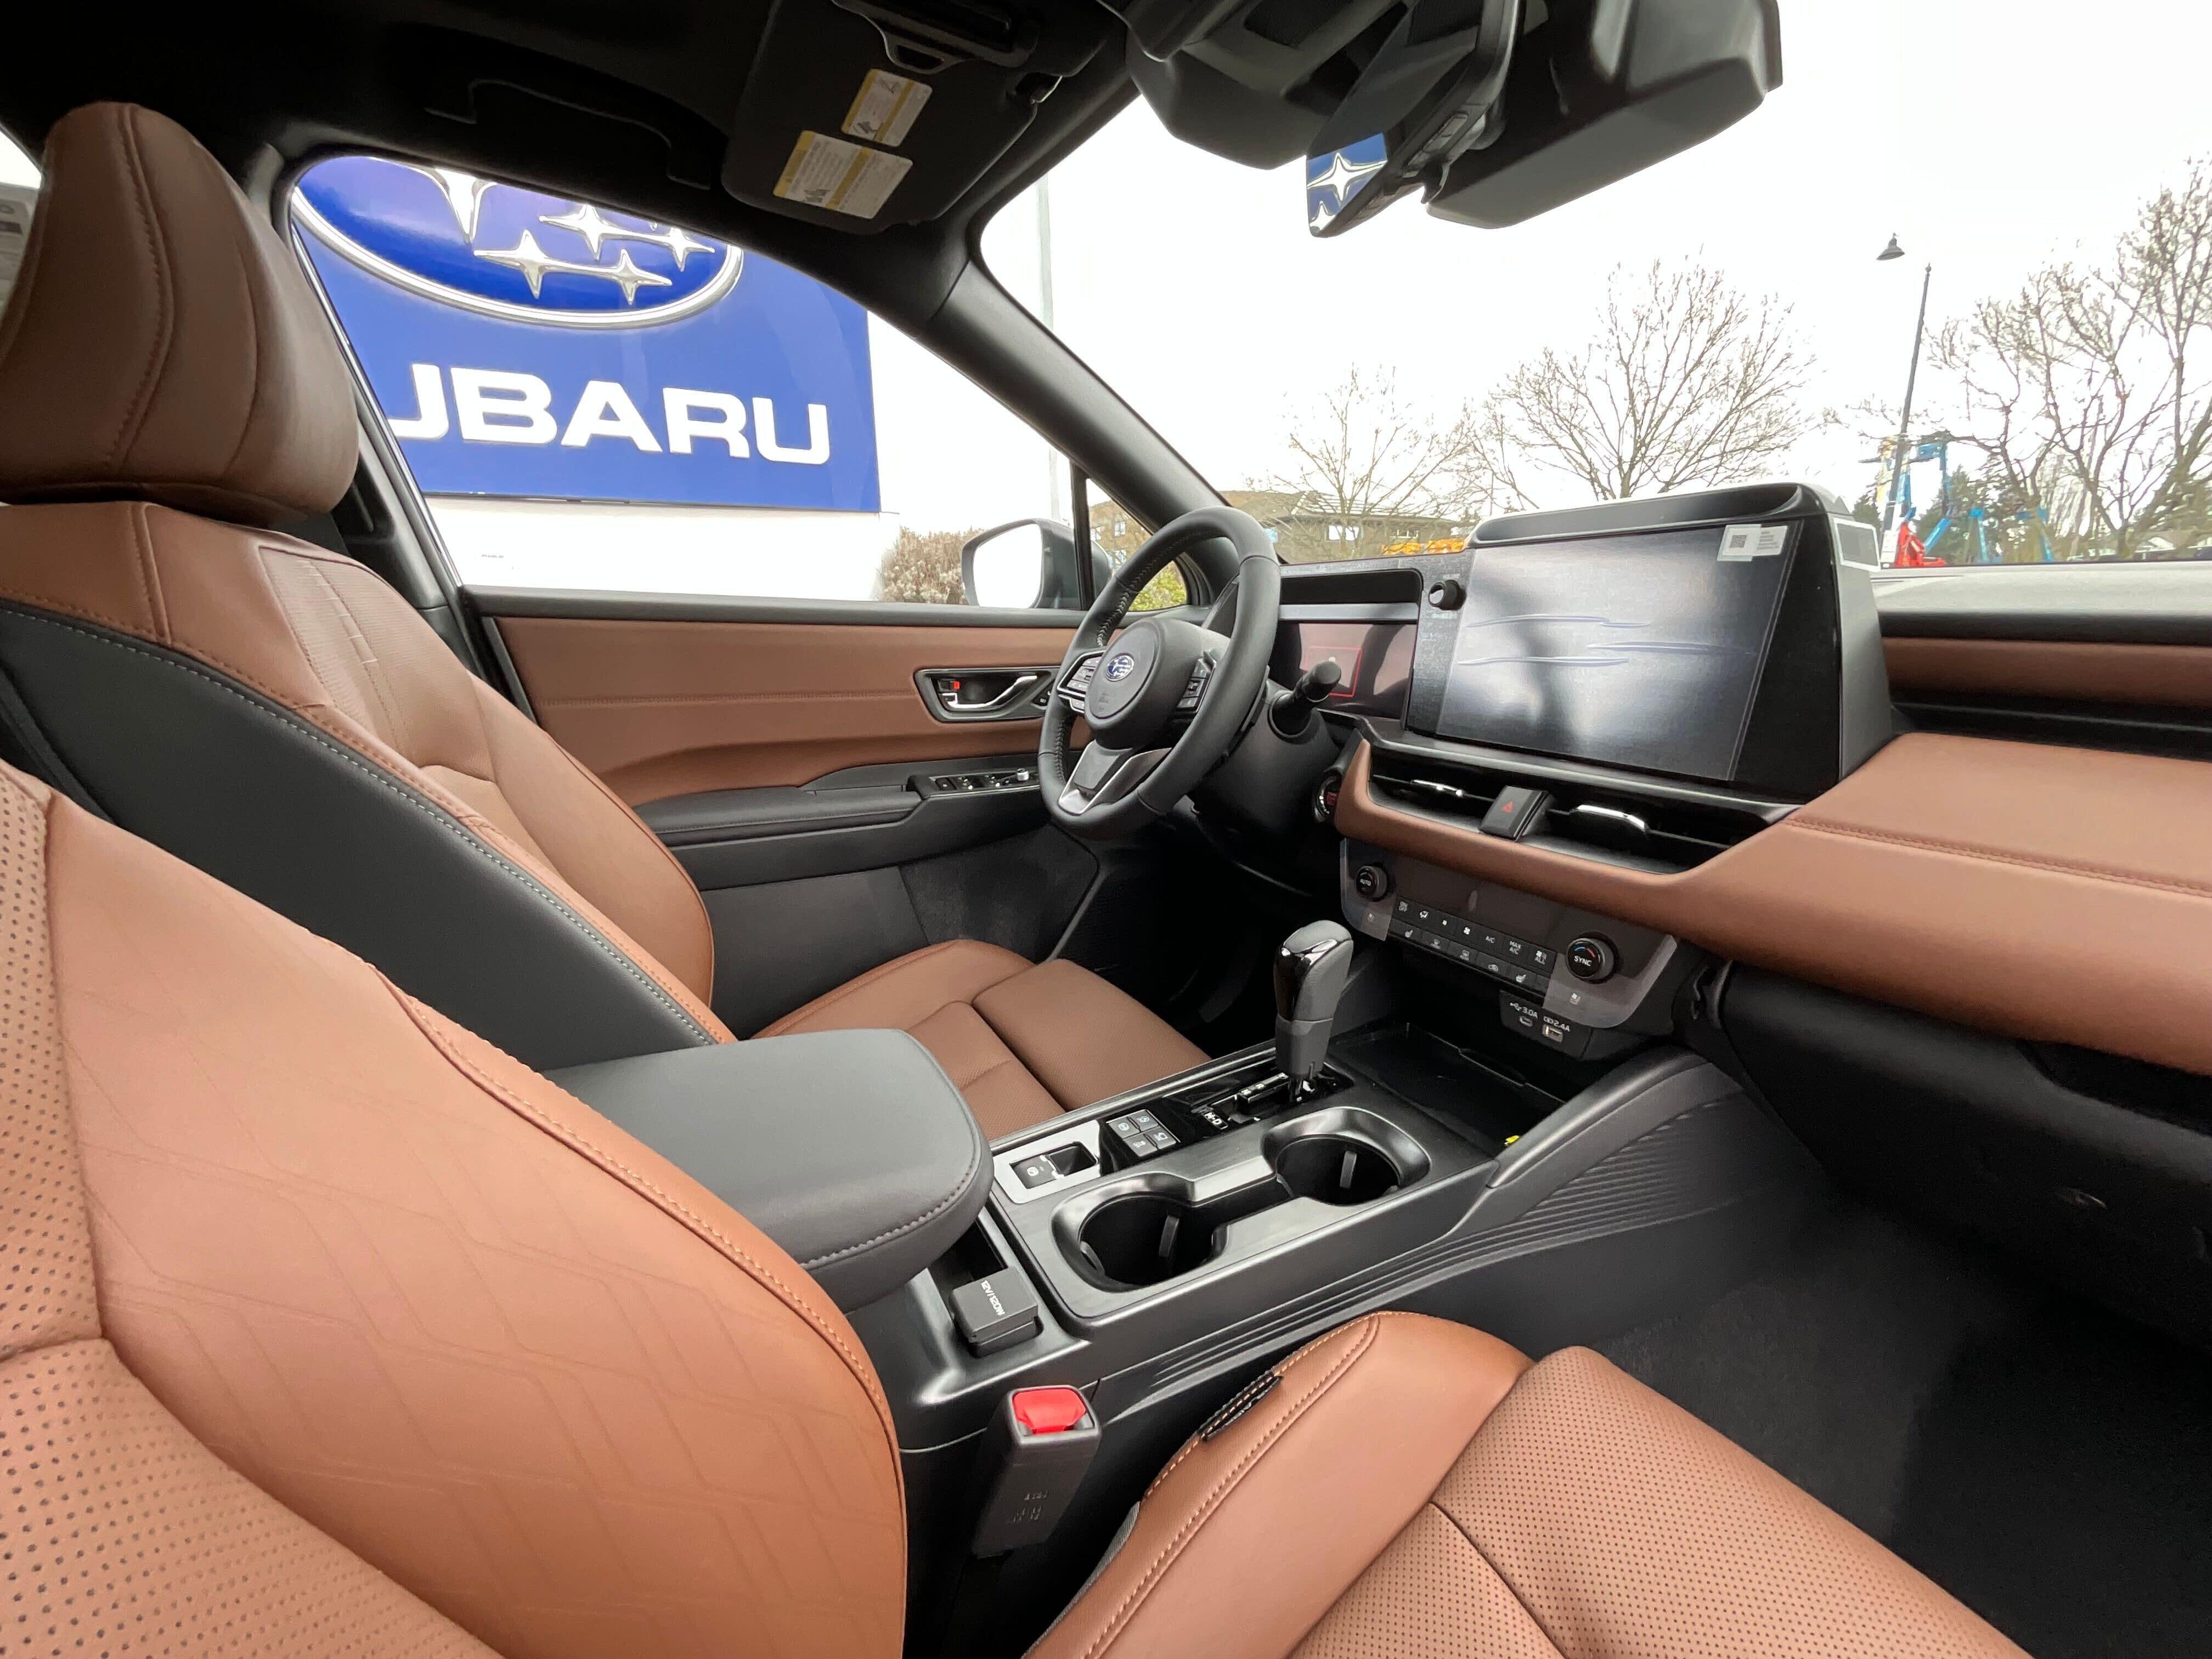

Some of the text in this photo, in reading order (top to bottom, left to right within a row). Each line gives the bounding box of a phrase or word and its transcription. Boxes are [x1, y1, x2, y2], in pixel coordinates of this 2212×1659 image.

[387, 363, 830, 465] UBARU
[1359, 878, 1372, 887] AUTO
[1509, 940, 1522, 949] MAX
[1573, 955, 1592, 967] SYNC
[980, 1280, 1006, 1316] 12V/120W
